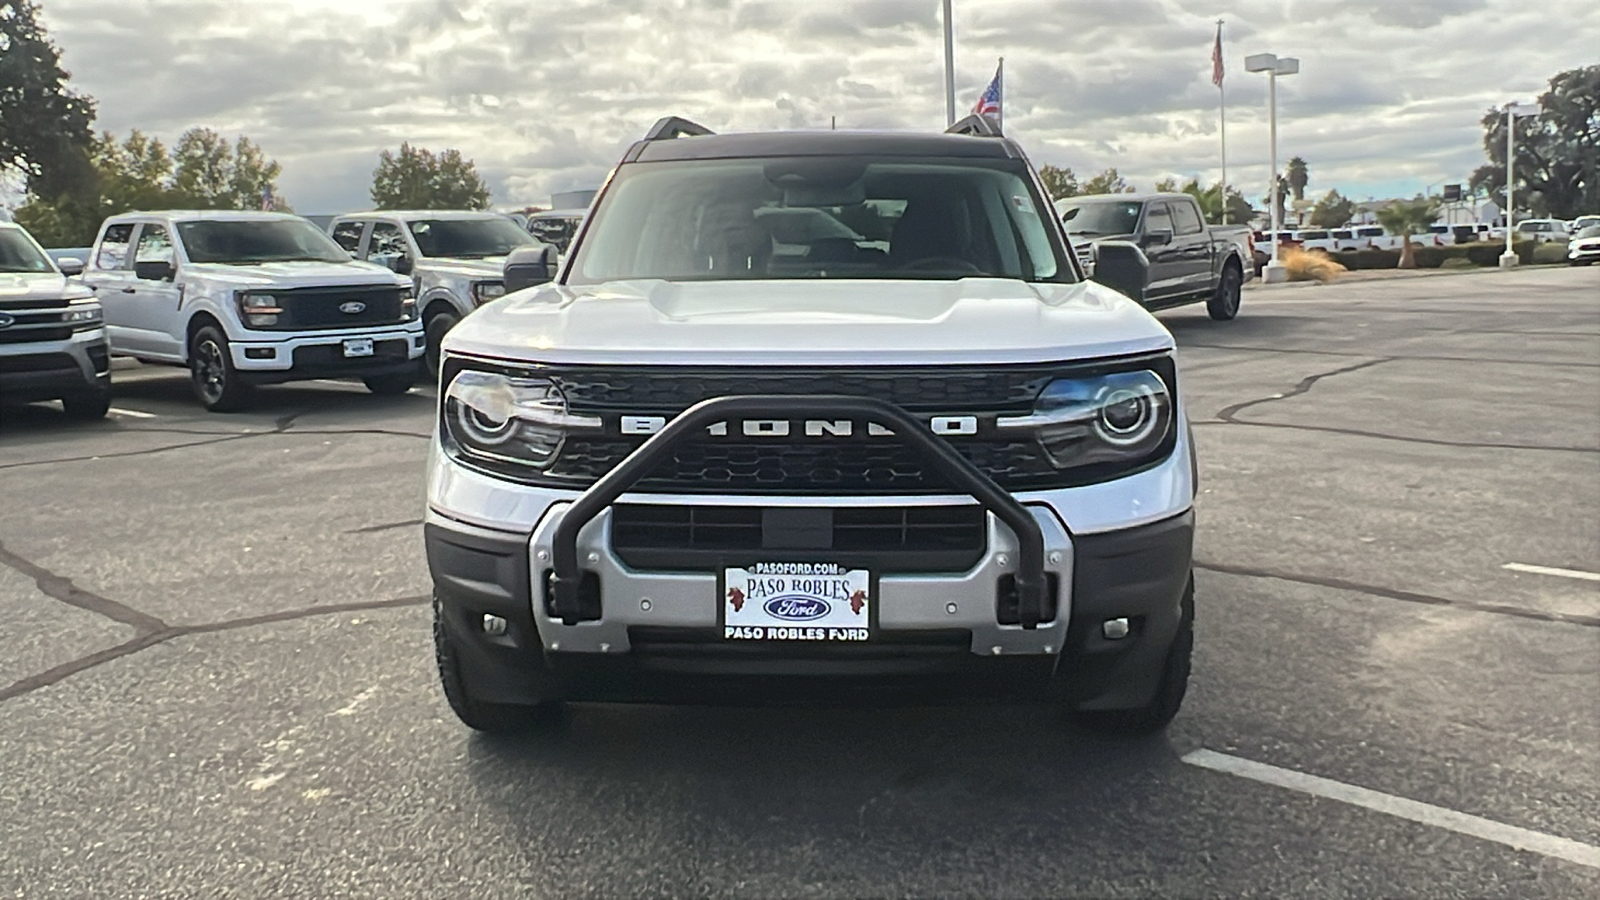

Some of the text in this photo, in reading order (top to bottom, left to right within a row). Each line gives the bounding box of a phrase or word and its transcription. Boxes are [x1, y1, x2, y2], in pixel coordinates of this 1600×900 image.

[756, 562, 838, 575] PASOFORD.COM
[747, 578, 850, 601] PASO ROBLES
[777, 600, 818, 616] Ford
[725, 627, 869, 641] PASO ROBLES FORD
